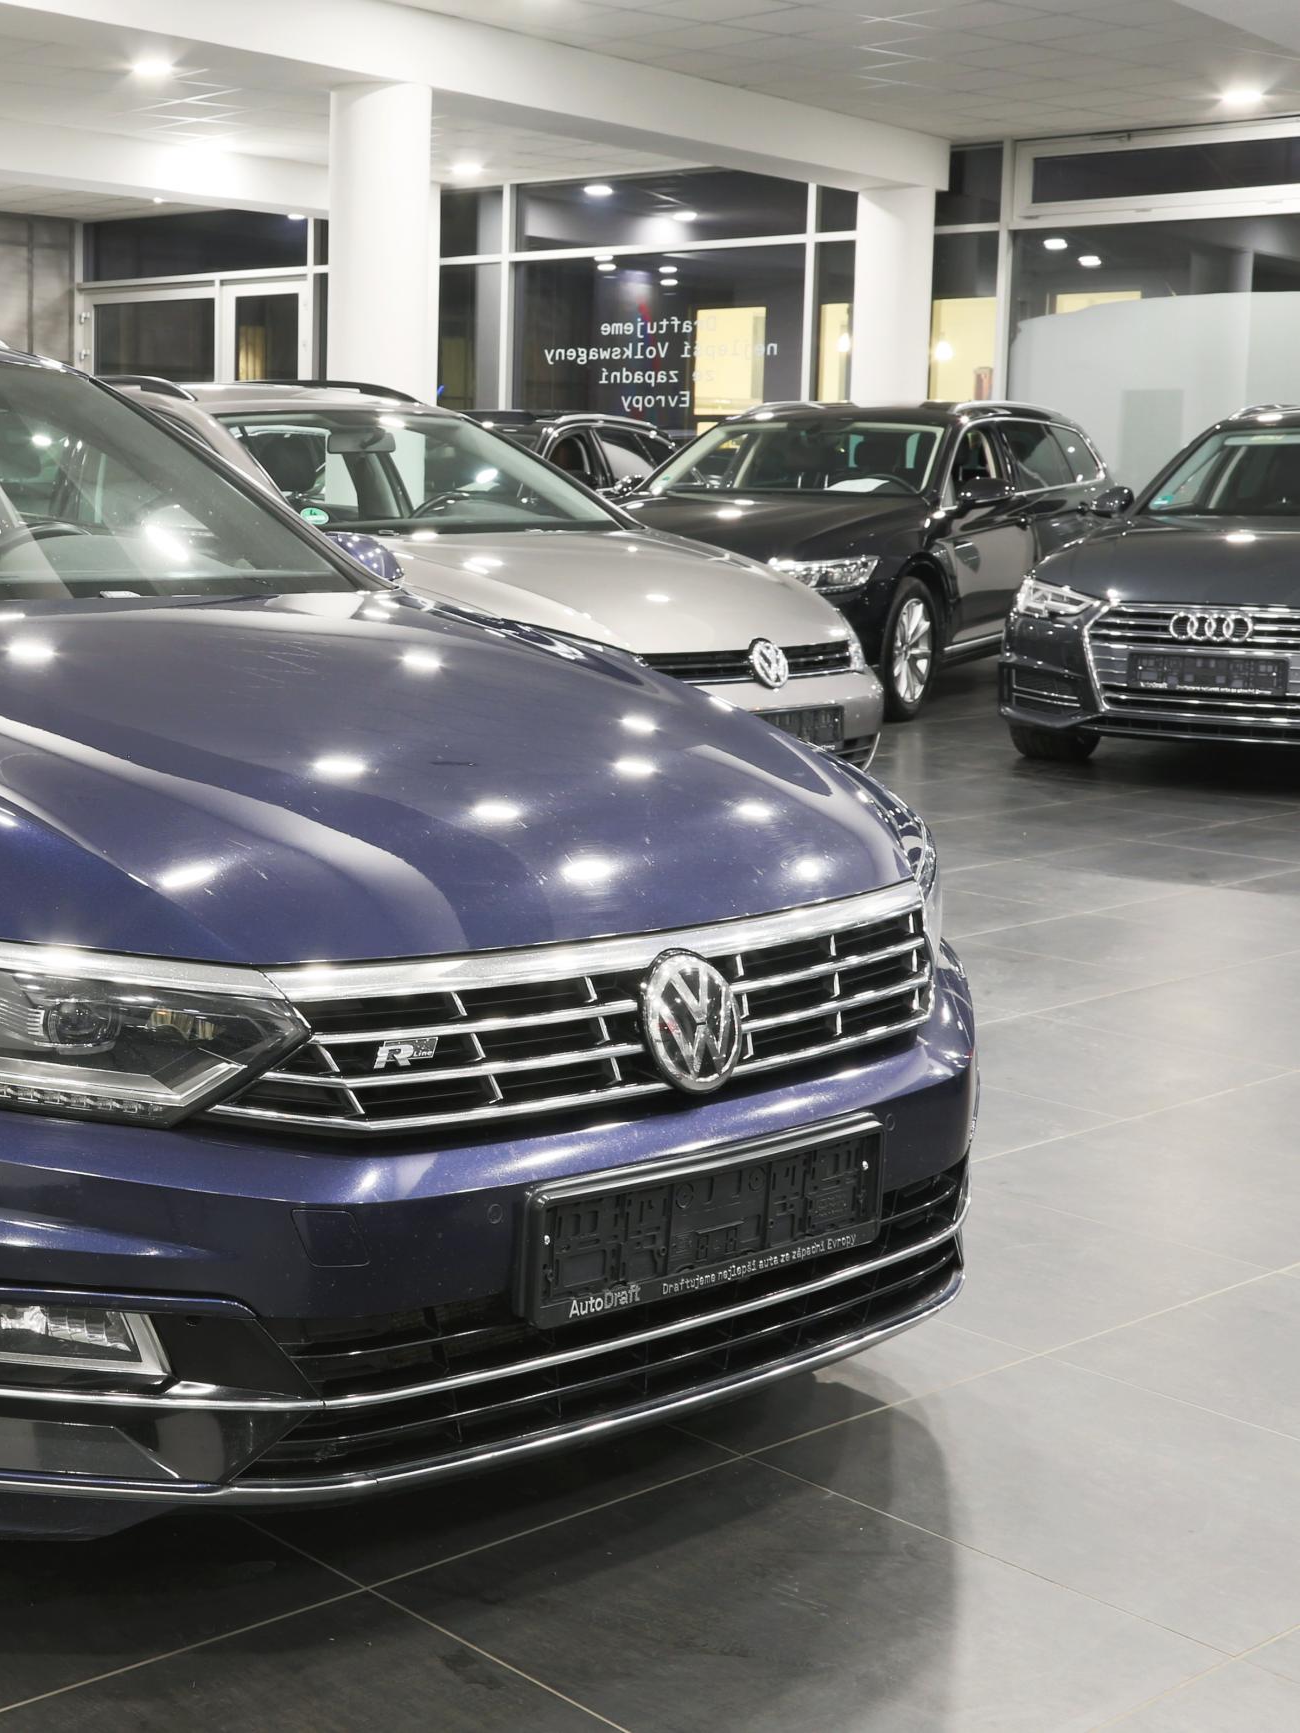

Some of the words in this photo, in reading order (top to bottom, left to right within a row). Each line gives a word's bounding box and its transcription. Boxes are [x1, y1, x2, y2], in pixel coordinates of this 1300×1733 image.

[647, 954, 740, 1089] VW
[662, 1275, 715, 1294] Draftujeme
[827, 1234, 856, 1250] Evropy
[569, 1284, 641, 1318] AutoDraft
